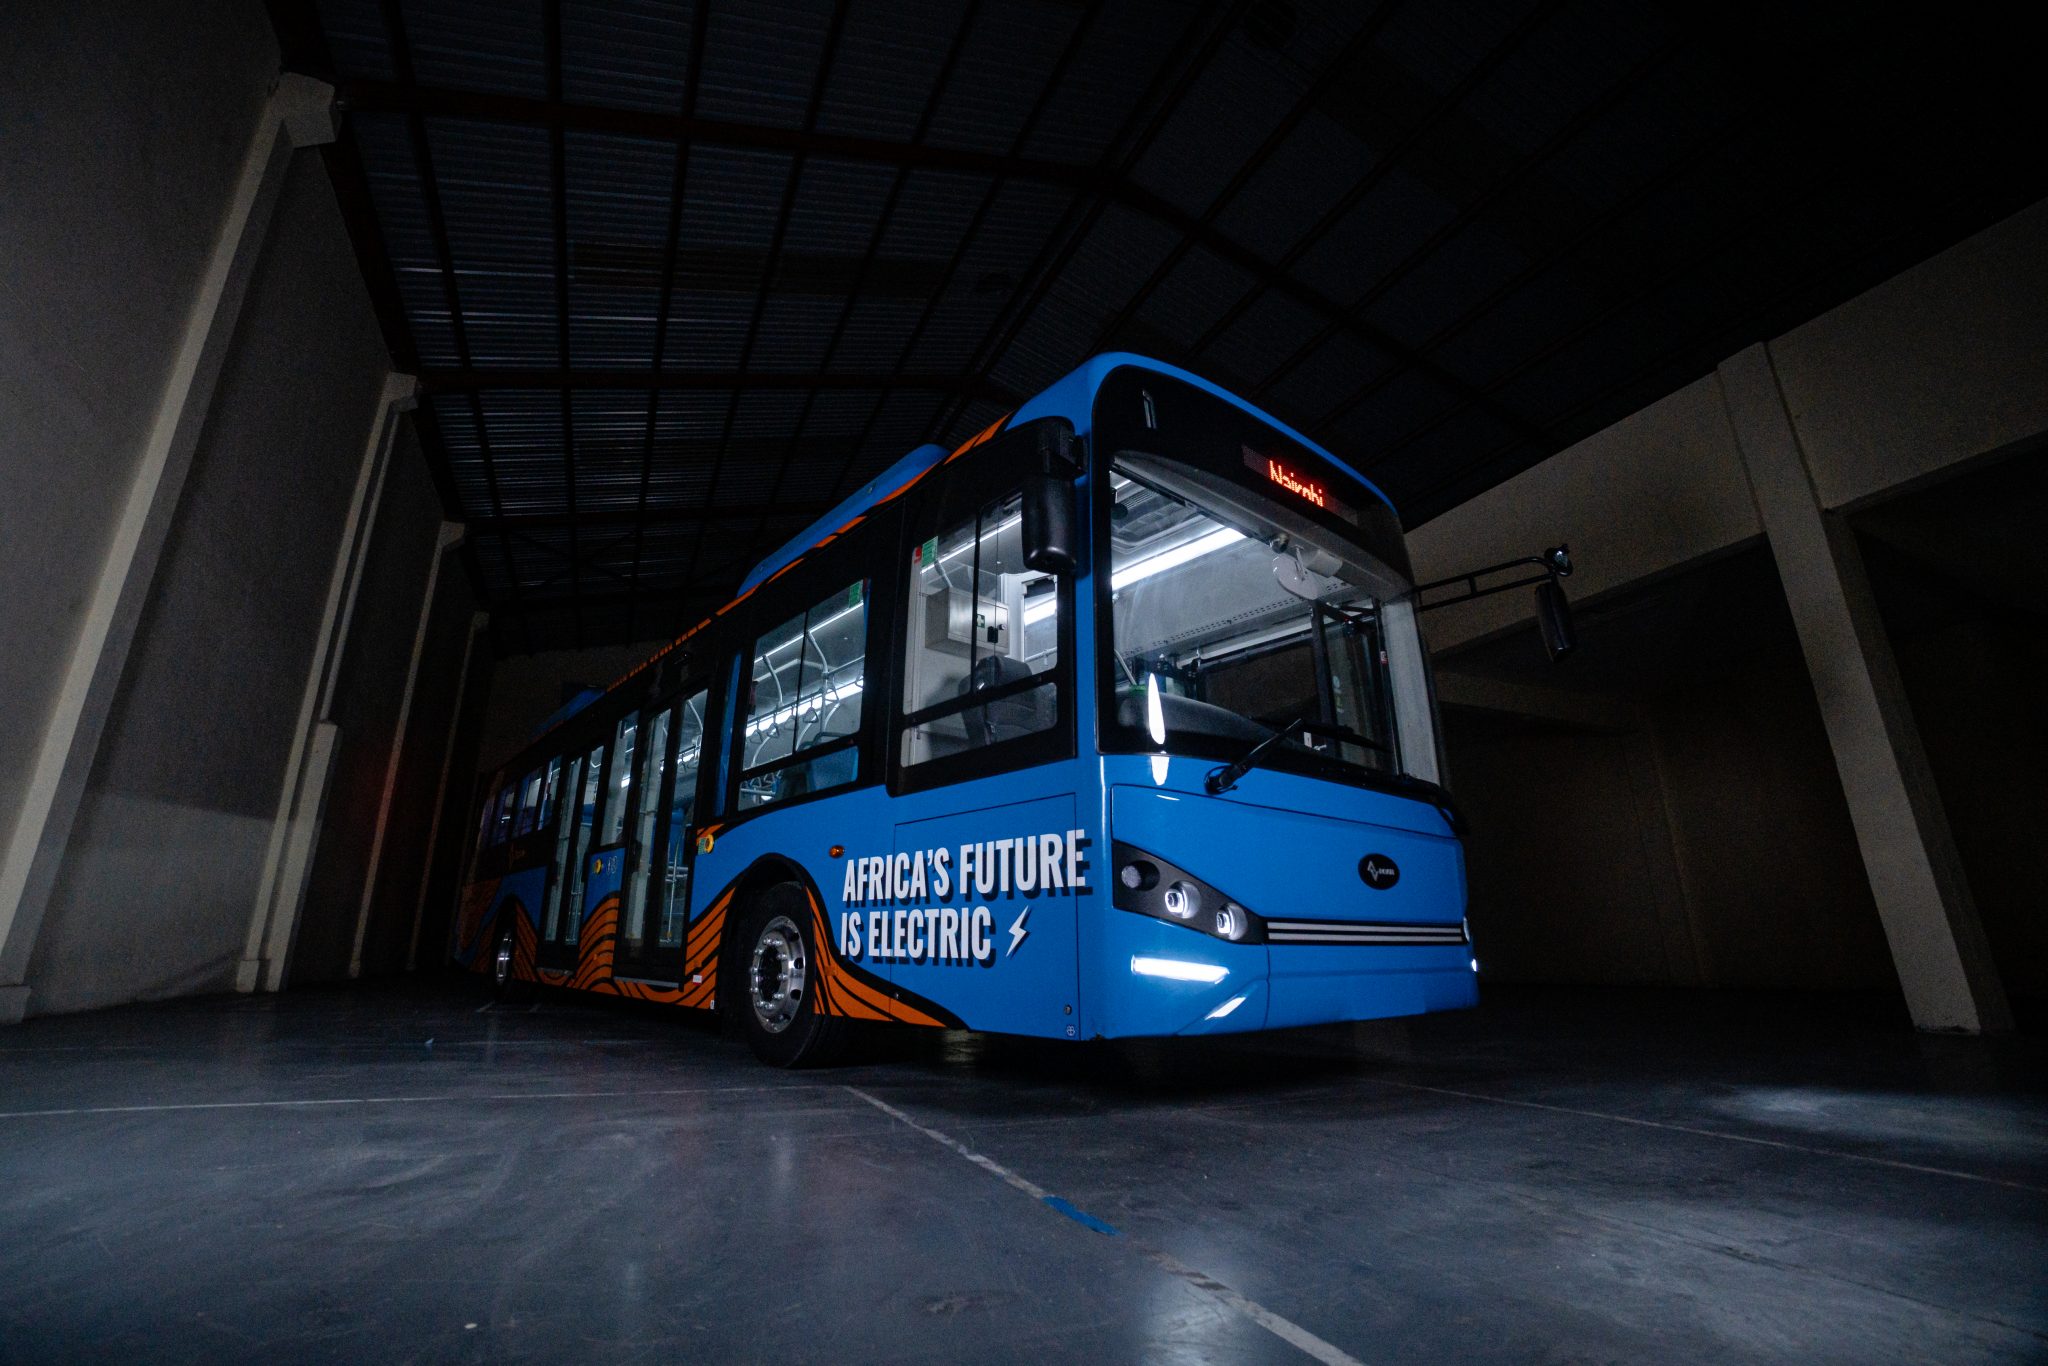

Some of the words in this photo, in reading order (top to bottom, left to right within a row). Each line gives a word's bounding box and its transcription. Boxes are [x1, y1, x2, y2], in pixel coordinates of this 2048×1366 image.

[842, 847, 951, 902] AFRICA'S
[959, 828, 1086, 895] FUTURE
[840, 911, 862, 957] IS
[868, 905, 992, 960] ELECTRIC
